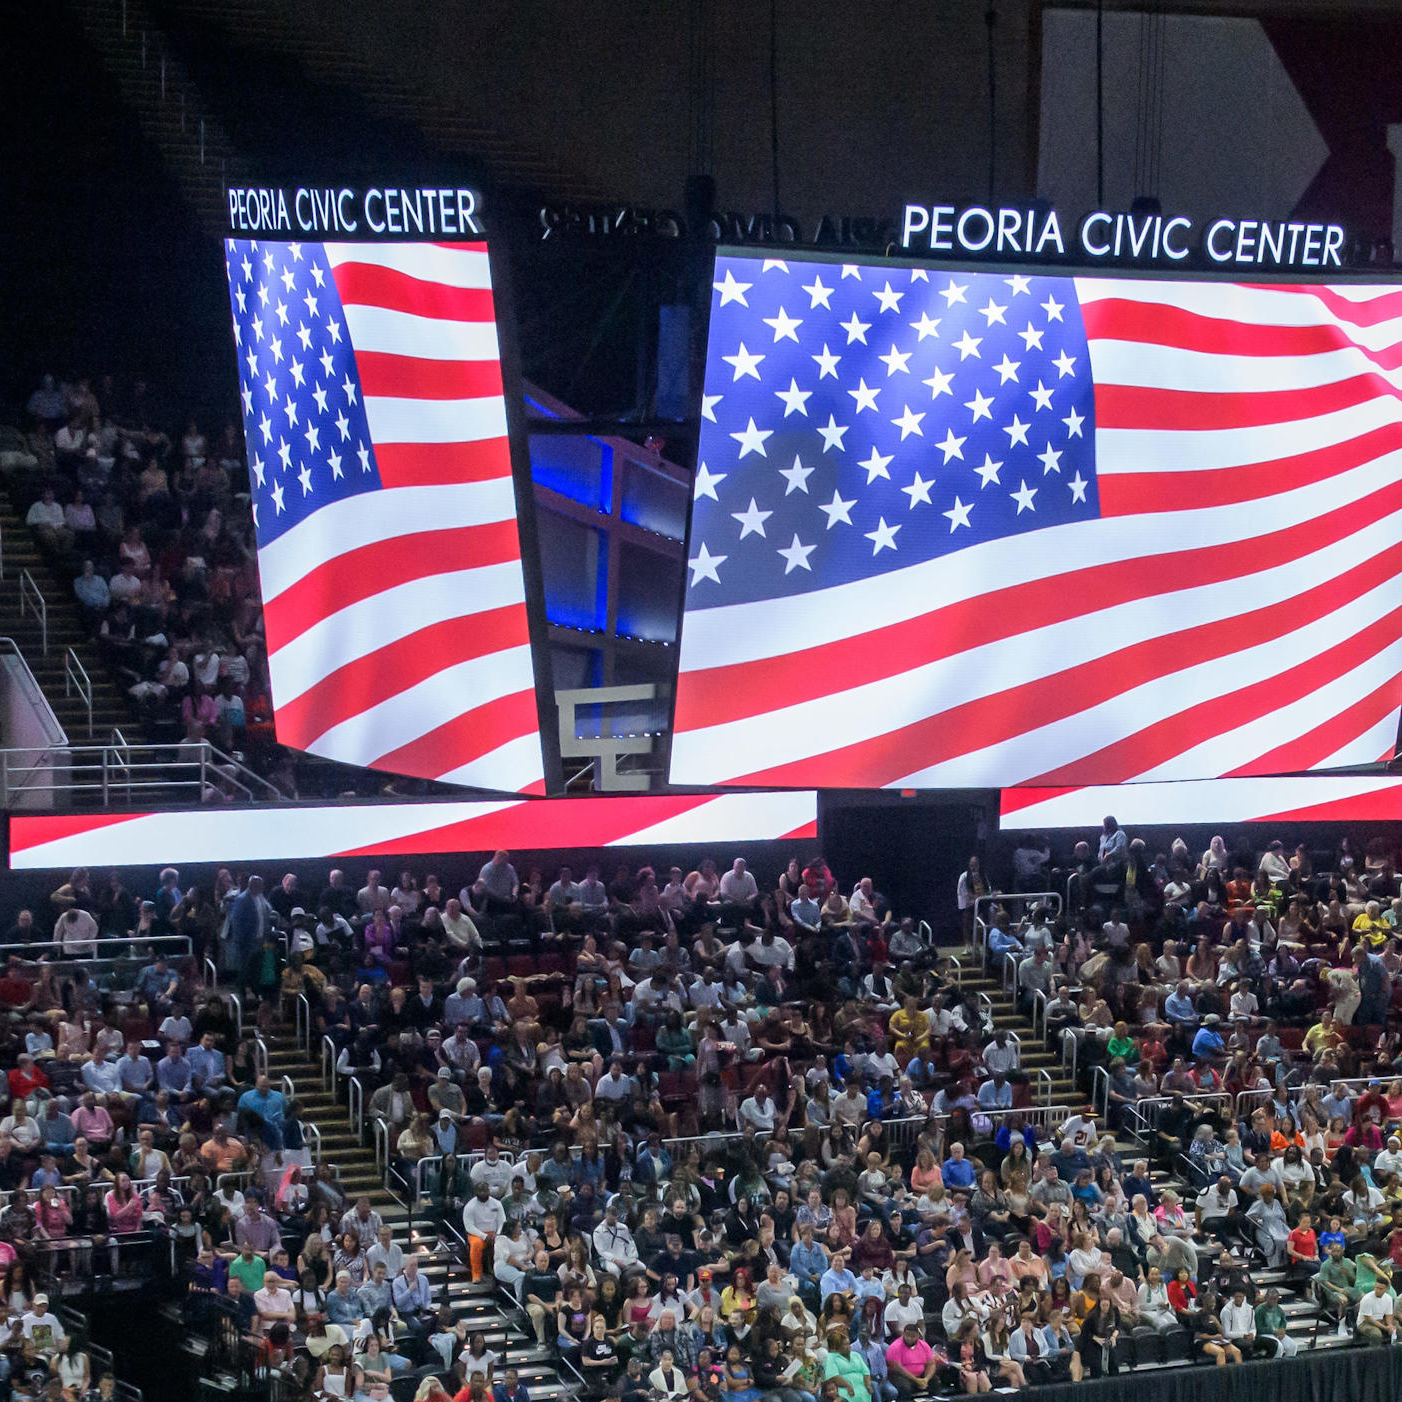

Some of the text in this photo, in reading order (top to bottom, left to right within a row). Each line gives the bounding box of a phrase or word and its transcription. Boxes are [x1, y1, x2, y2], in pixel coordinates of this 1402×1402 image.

[228, 188, 480, 234] PEORIA CIVIC CENTER
[902, 204, 1065, 254] PEORIA
[1081, 212, 1192, 260] CIVIC
[1206, 219, 1344, 266] CENTER
[1074, 1130, 1088, 1145] 21
